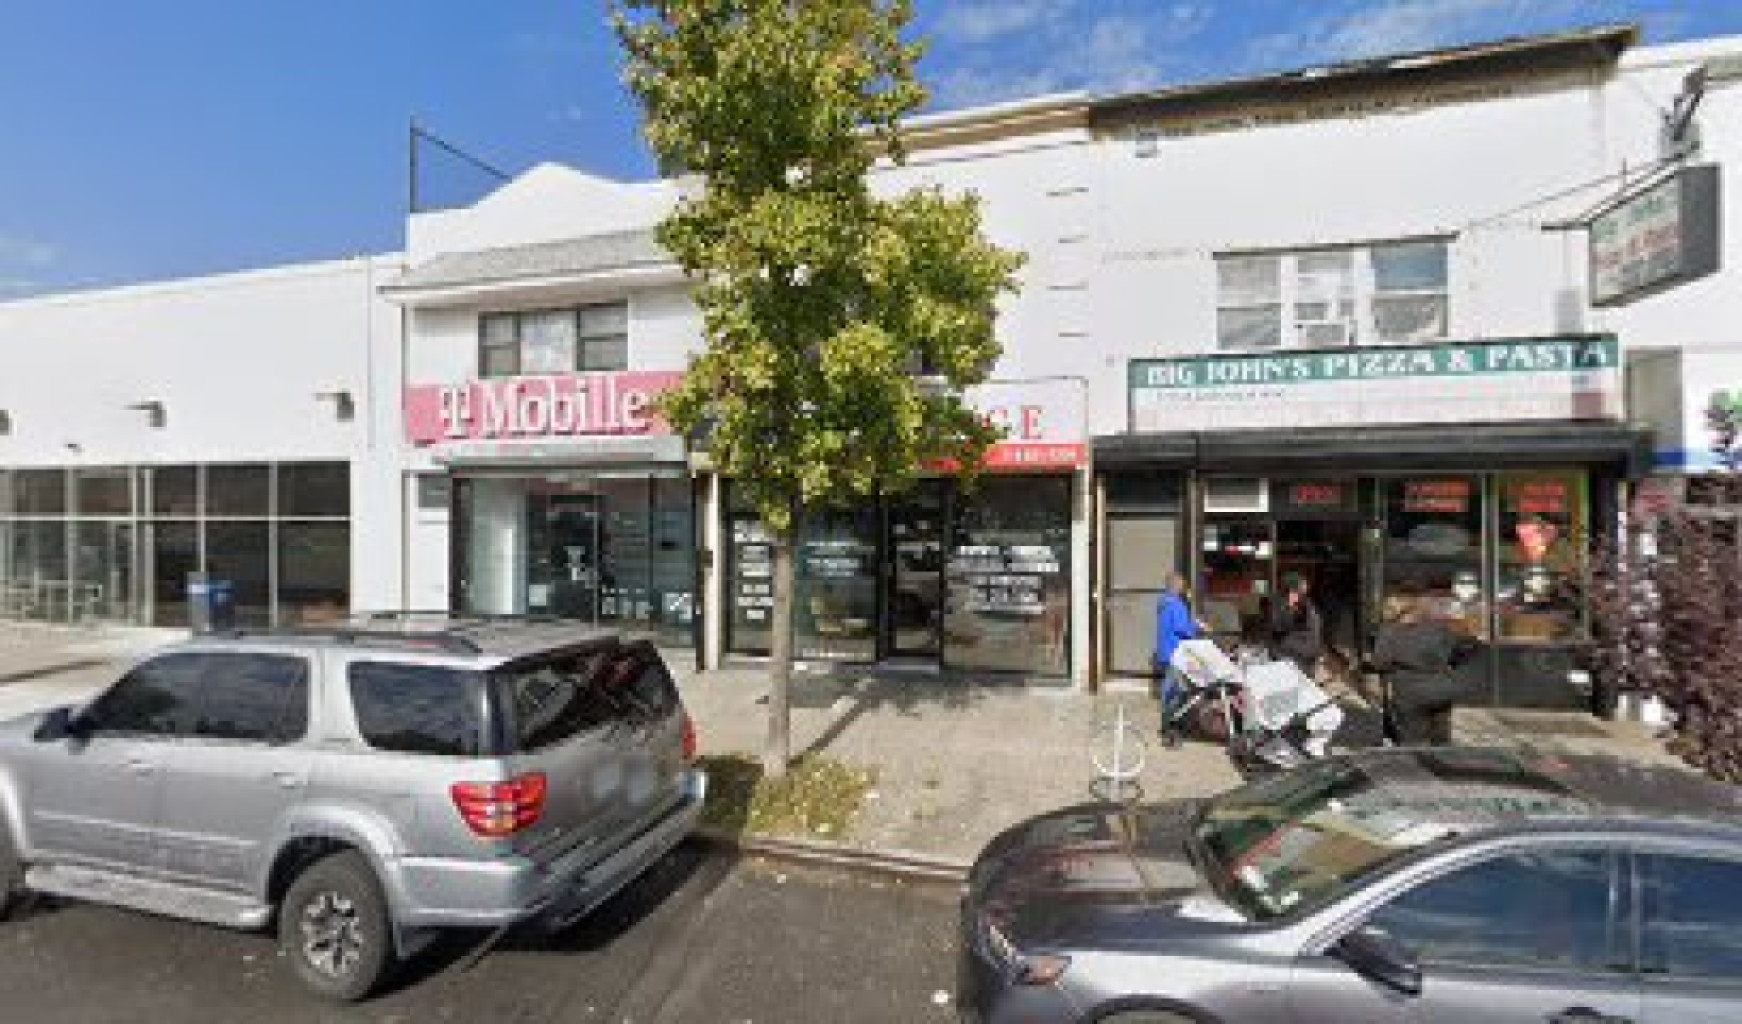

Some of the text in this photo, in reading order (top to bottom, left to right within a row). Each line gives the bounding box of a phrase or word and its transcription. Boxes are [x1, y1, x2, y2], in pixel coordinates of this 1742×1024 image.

[1147, 362, 1196, 386] BIG
[1322, 350, 1435, 377] PIZZA
[1448, 350, 1474, 372] &
[1486, 342, 1608, 370] PASTA
